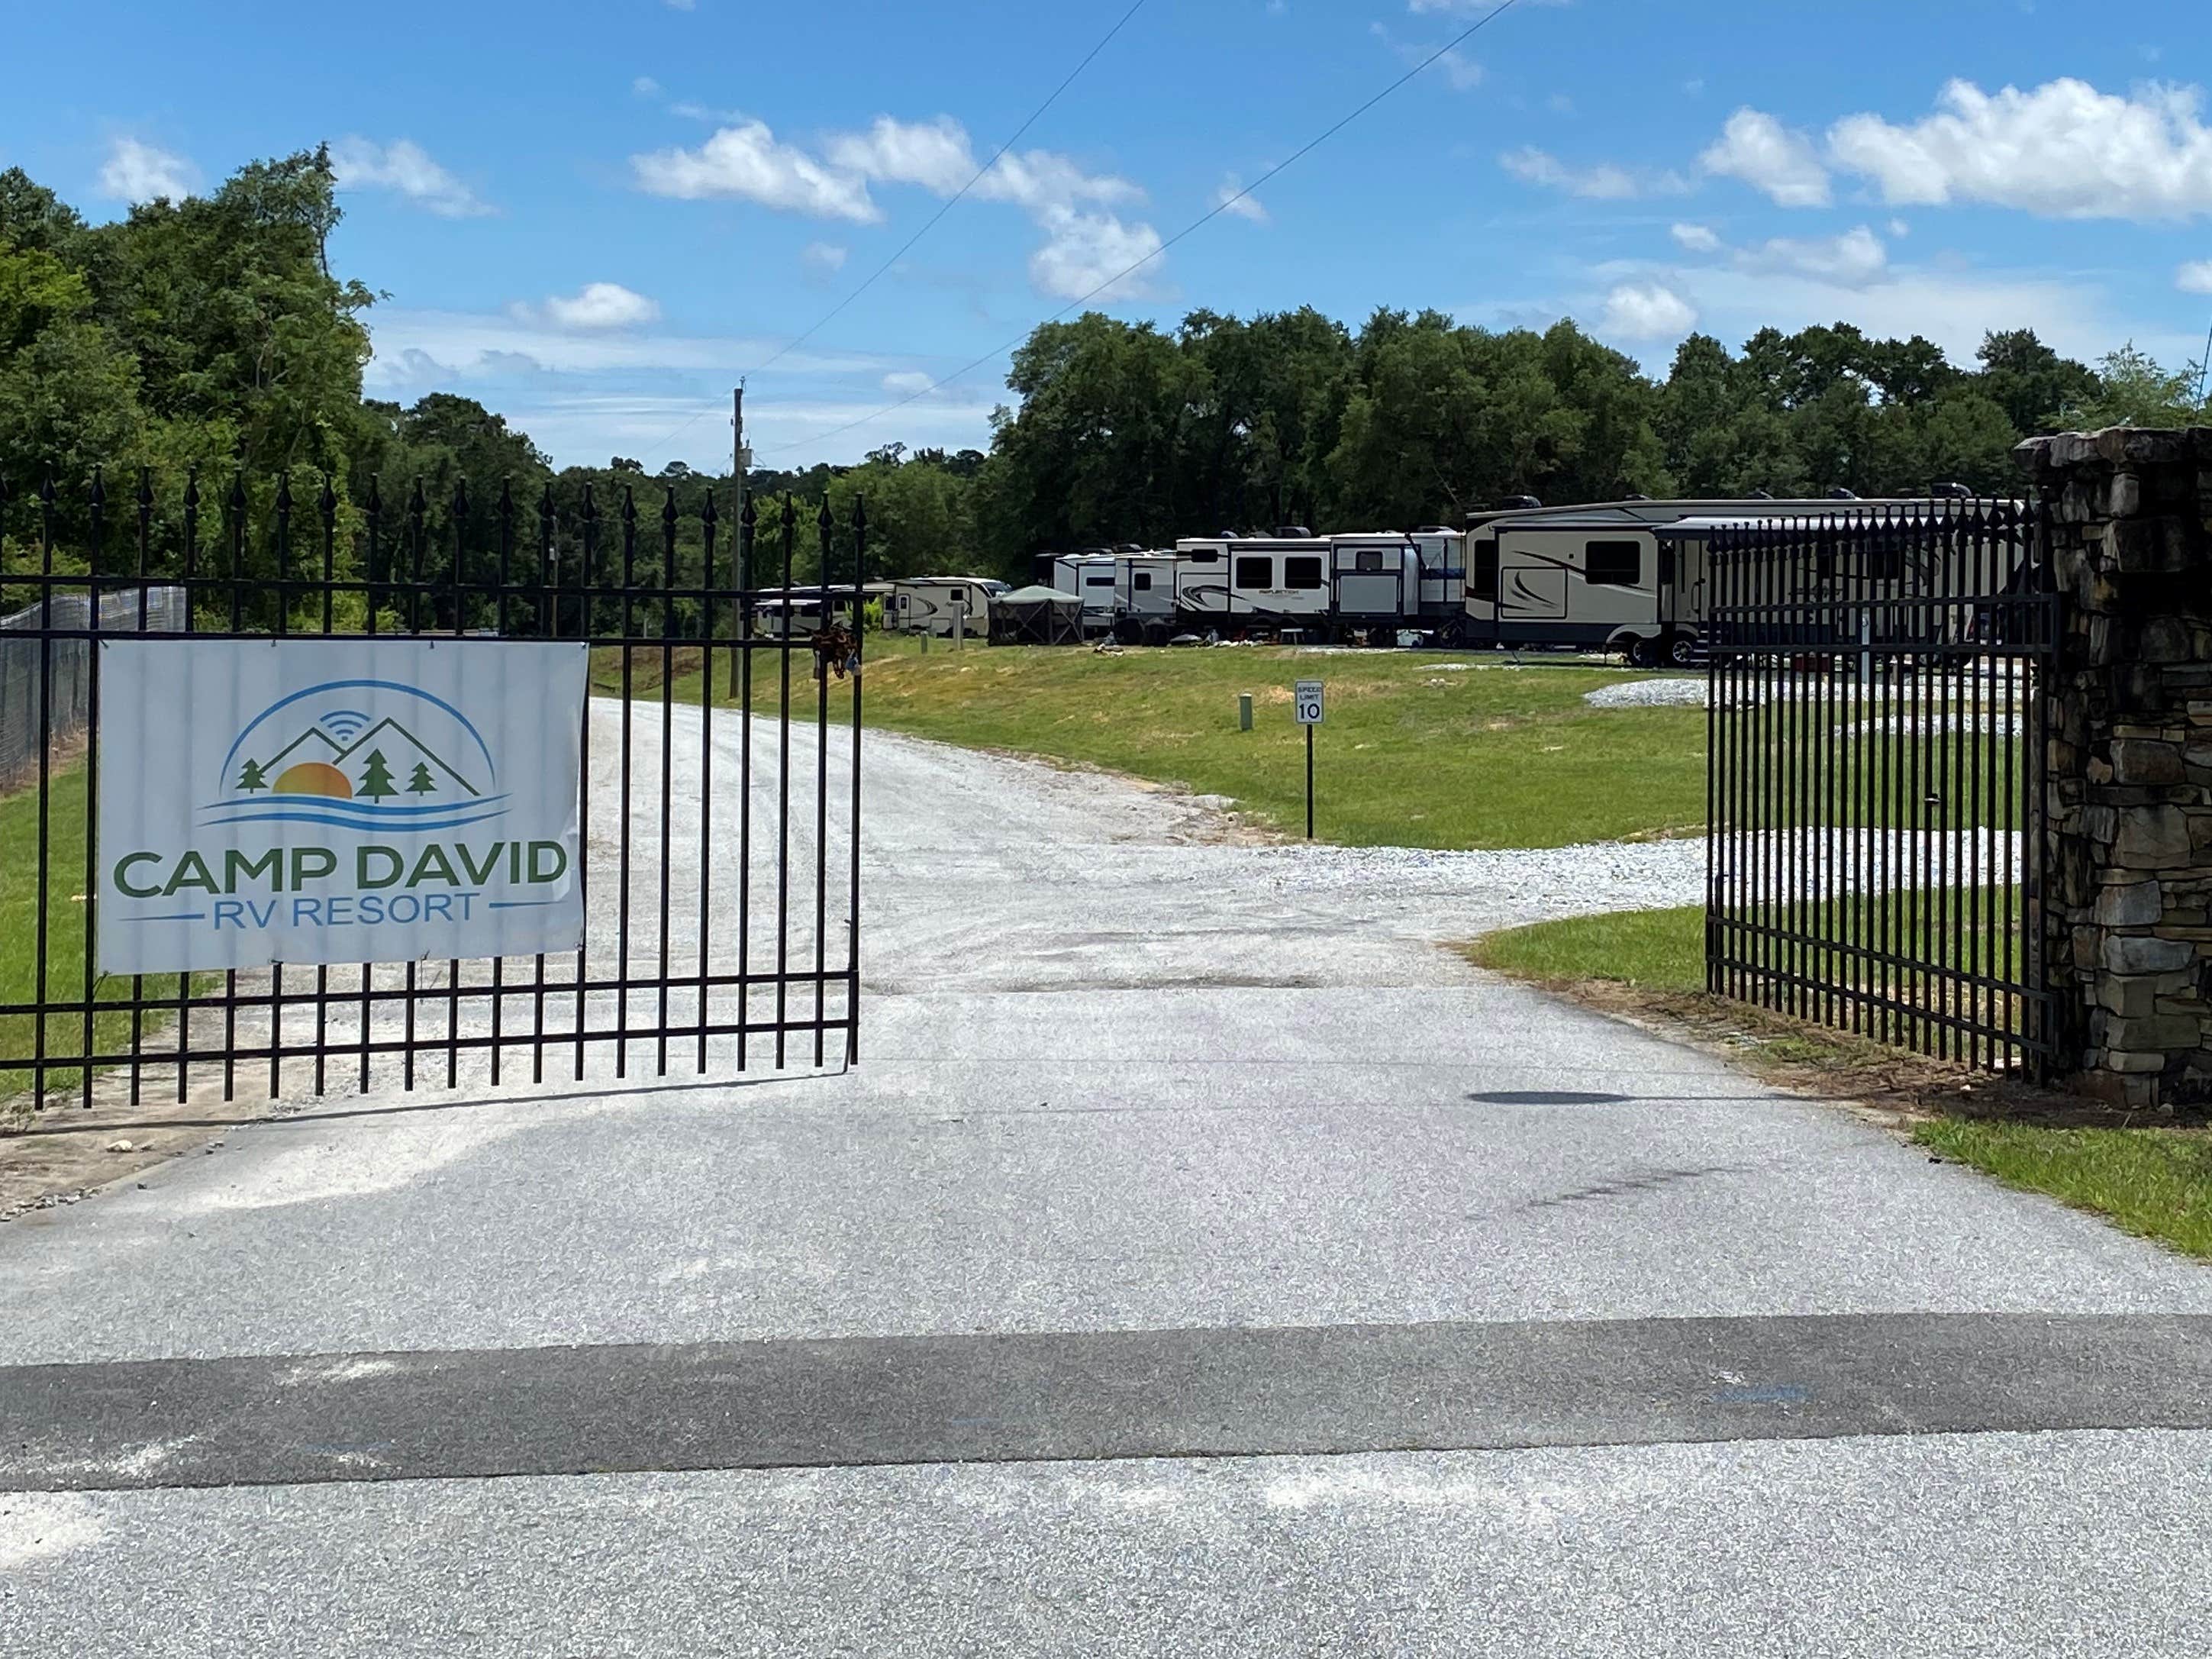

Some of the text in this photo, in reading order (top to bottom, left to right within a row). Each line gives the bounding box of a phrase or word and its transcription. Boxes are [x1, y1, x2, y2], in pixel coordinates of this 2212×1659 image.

[1299, 703, 1320, 719] 10
[113, 840, 569, 899] CAMP DAVID
[214, 892, 481, 930] RV RESORT
